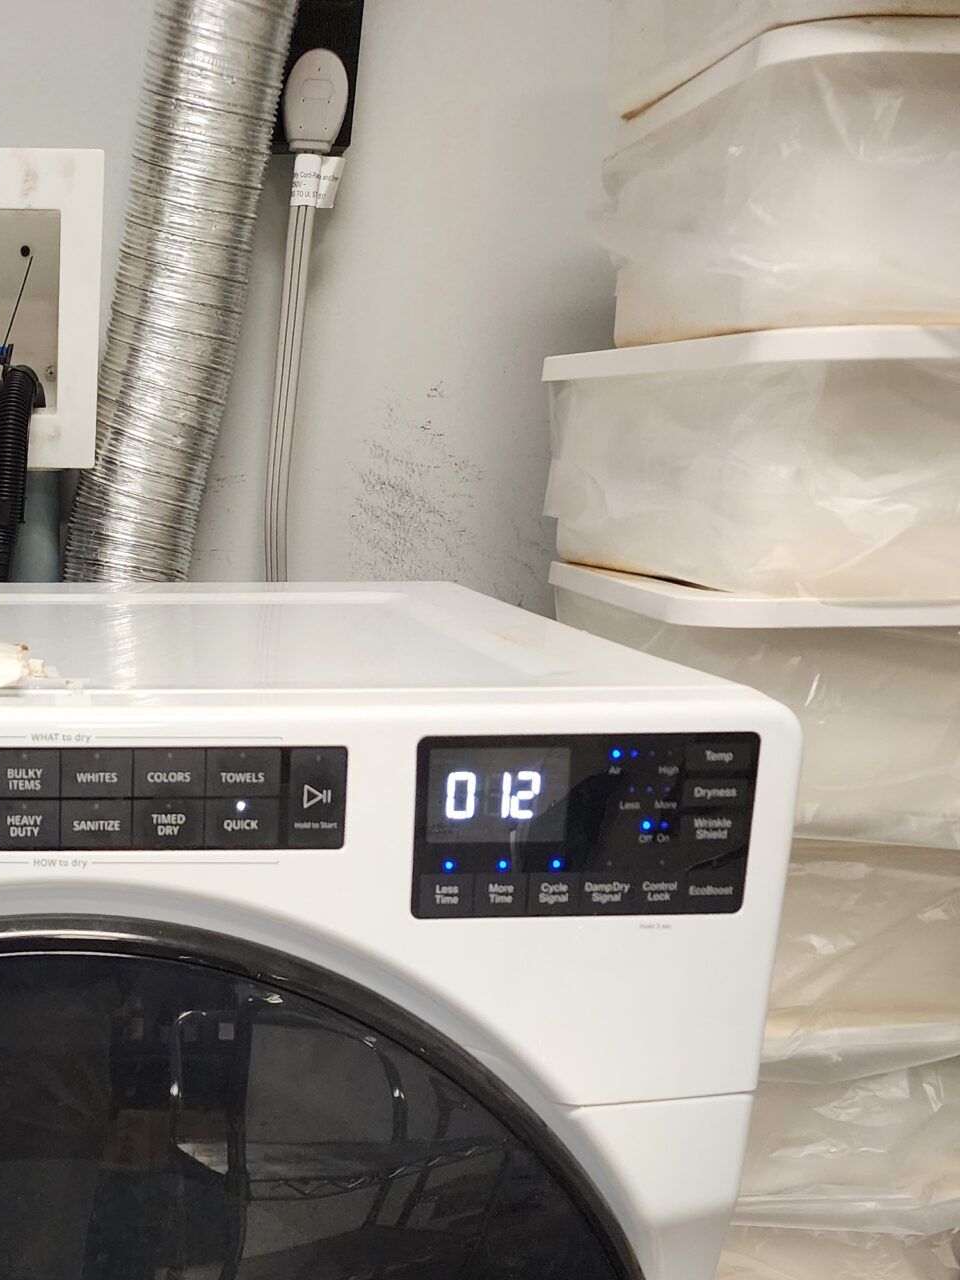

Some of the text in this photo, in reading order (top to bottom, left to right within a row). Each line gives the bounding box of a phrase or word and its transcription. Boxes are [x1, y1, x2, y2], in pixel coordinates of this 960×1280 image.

[31, 733, 92, 743] WHAT to dry
[705, 750, 734, 763] Temp
[7, 768, 42, 779] BULKY
[608, 766, 622, 774] Air
[658, 766, 679, 776] High
[76, 772, 118, 783] WHITES
[147, 772, 191, 783] COLORS
[220, 772, 265, 783] TOWELS
[9, 780, 41, 791] ITEMS
[694, 787, 738, 799] Dryness
[619, 801, 640, 810] Less
[654, 801, 677, 809] More
[7, 815, 42, 826] HEAVY
[151, 814, 186, 825] TIMED
[223, 819, 258, 831] QUICK
[693, 818, 733, 828] Wrinkle
[73, 820, 121, 831] SANITIZE
[157, 825, 180, 836] DRY
[10, 826, 39, 837] DUTY
[696, 830, 728, 840] Shield
[638, 834, 670, 843] Off On
[34, 859, 88, 869] HOW to dry
[435, 884, 459, 894] Less
[489, 883, 514, 893] More
[541, 882, 568, 894] Cycle
[642, 881, 678, 891] Control
[689, 885, 733, 895] EcoBoost
[435, 894, 459, 905] Time
[489, 893, 513, 904] Time
[539, 893, 569, 905] Signal
[592, 893, 622, 904] Signal
[647, 892, 670, 901] Lock
